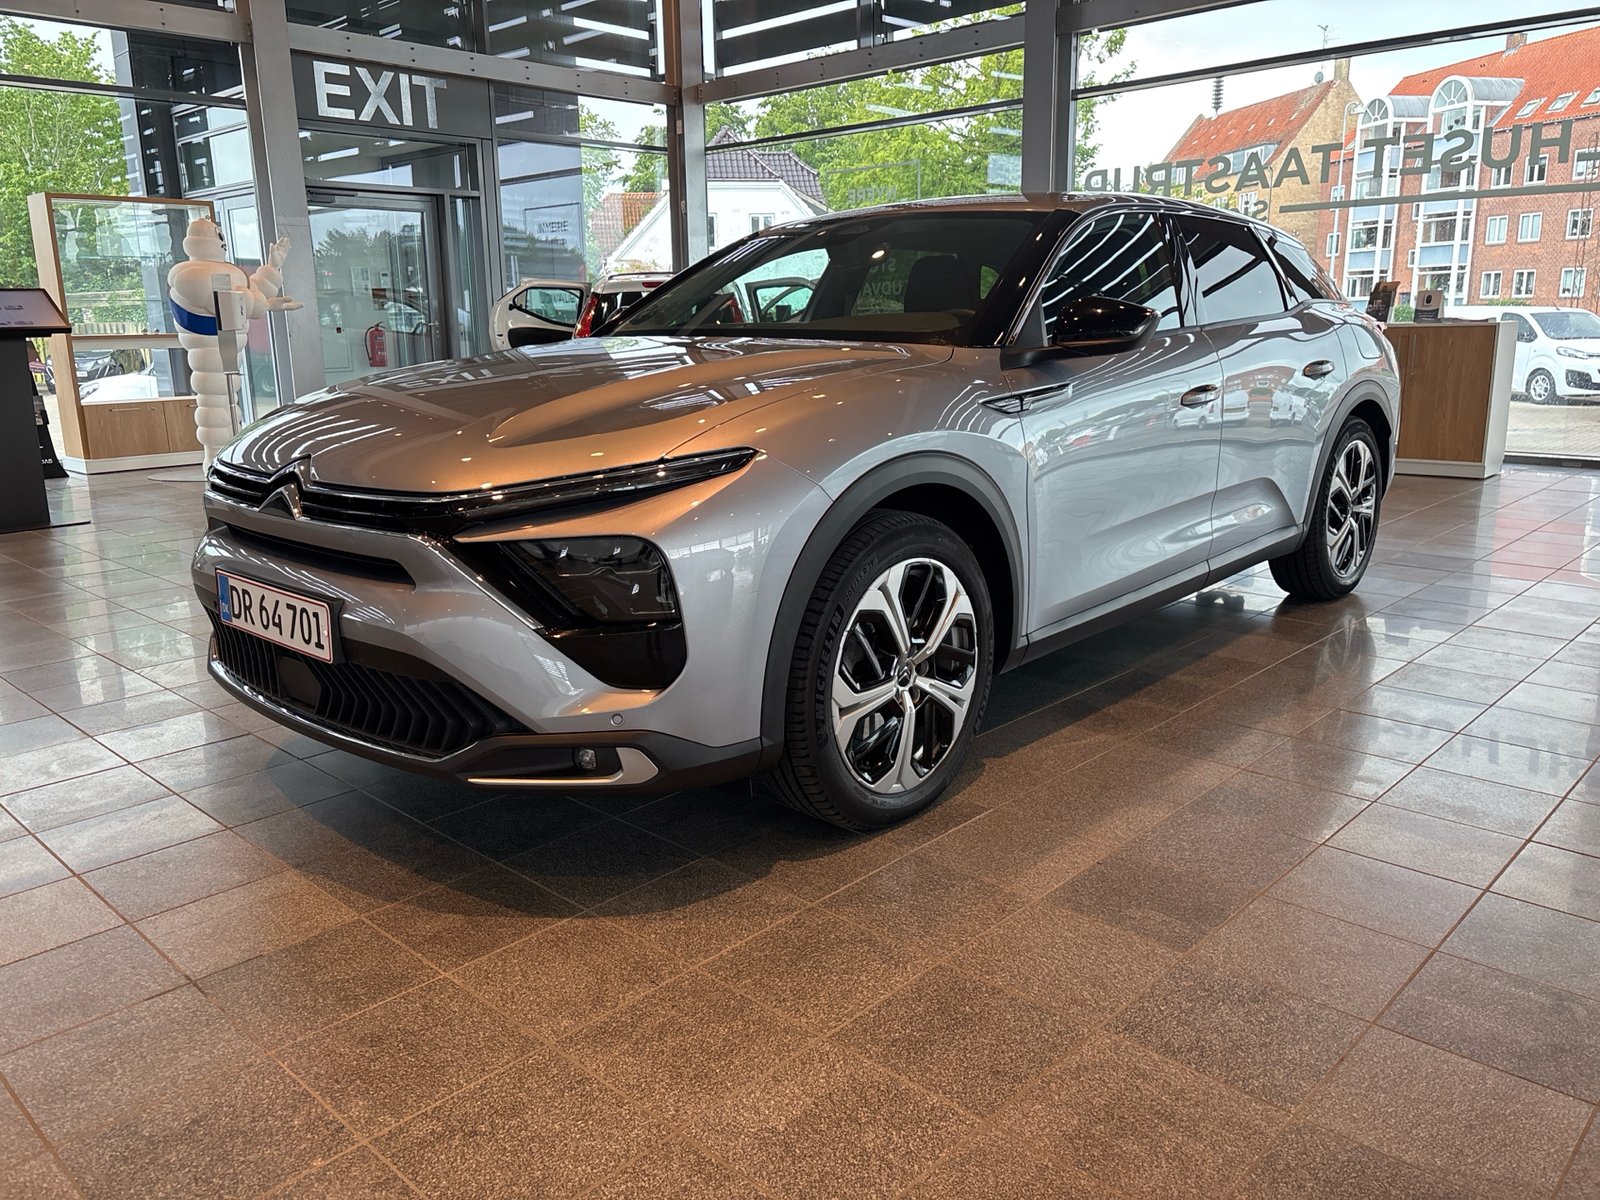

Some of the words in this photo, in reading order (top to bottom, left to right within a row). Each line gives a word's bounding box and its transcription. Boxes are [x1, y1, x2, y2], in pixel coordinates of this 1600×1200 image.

[312, 61, 448, 129] EXIT
[229, 584, 256, 626] DR
[259, 593, 284, 637] 64
[285, 602, 325, 651] 701
[815, 609, 844, 721] MICHELIN
